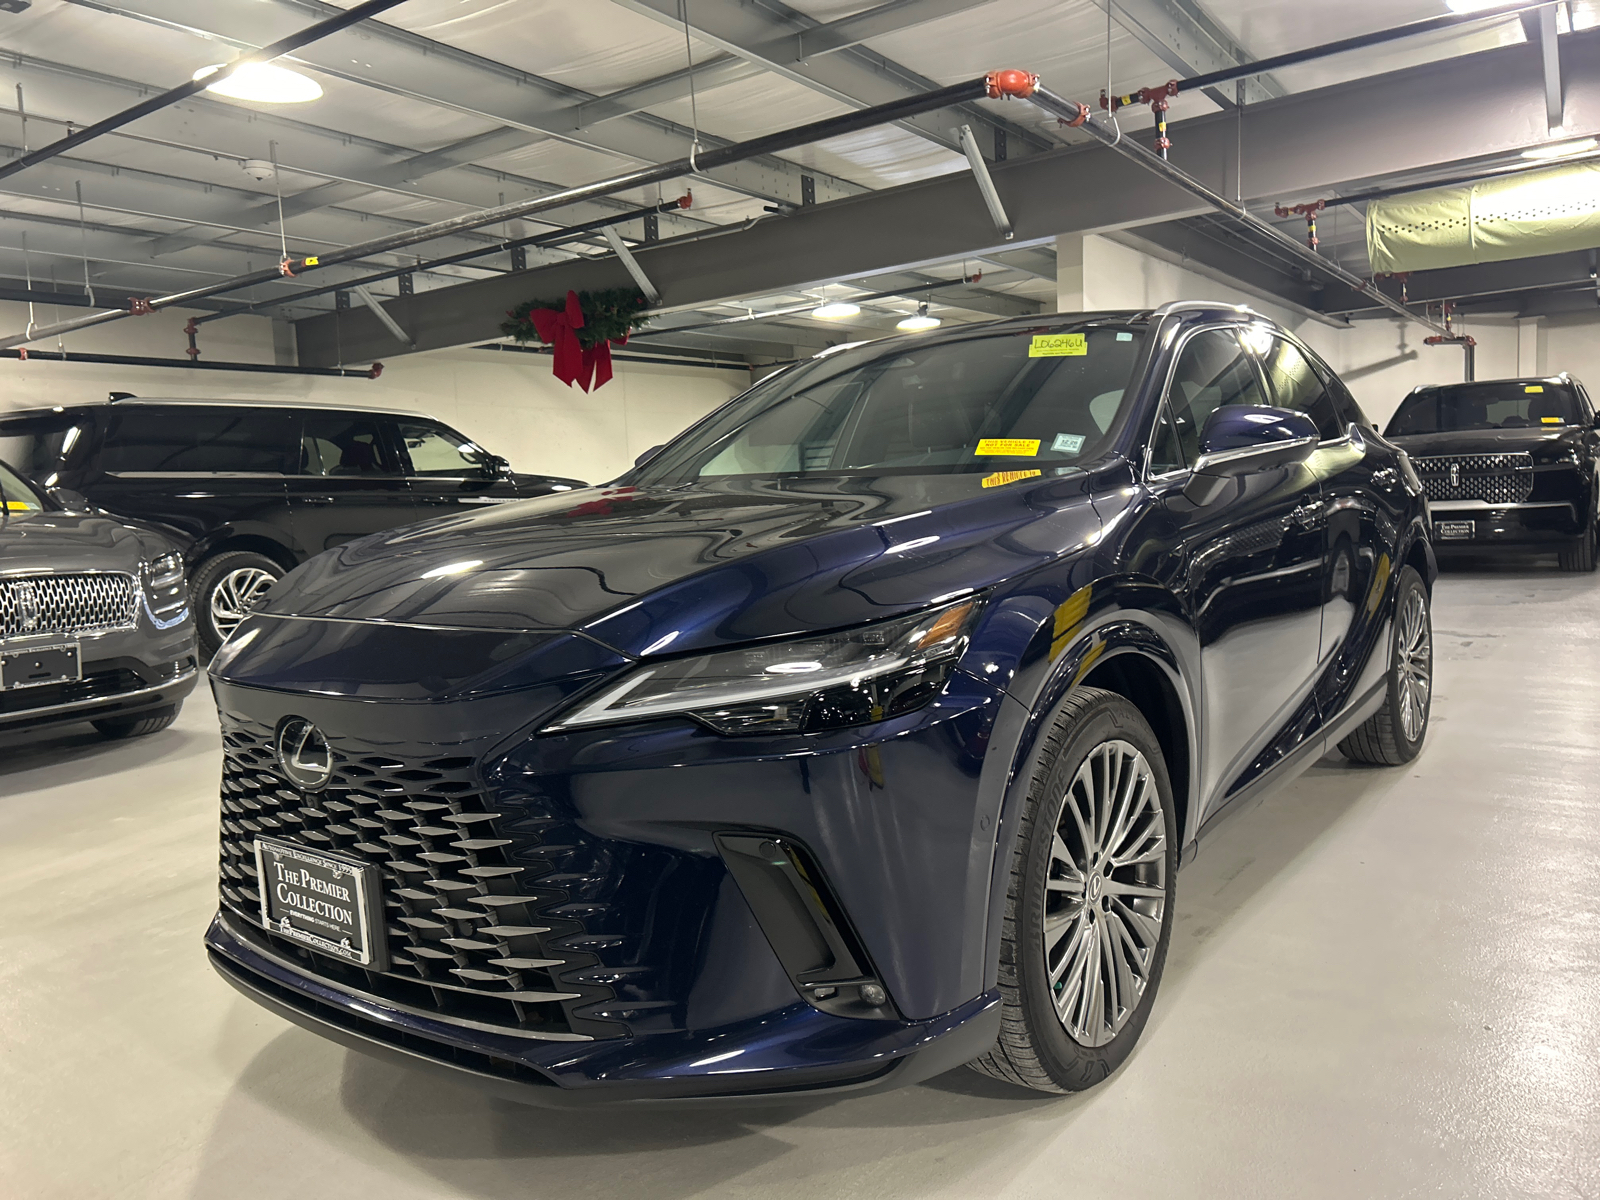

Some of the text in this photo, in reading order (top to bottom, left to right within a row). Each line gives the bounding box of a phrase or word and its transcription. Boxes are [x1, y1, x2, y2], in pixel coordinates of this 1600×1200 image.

[1030, 768, 1066, 948] BRIDGESTONE
[273, 861, 351, 903] THE PREMIER
[276, 883, 353, 926] COLLECTION
